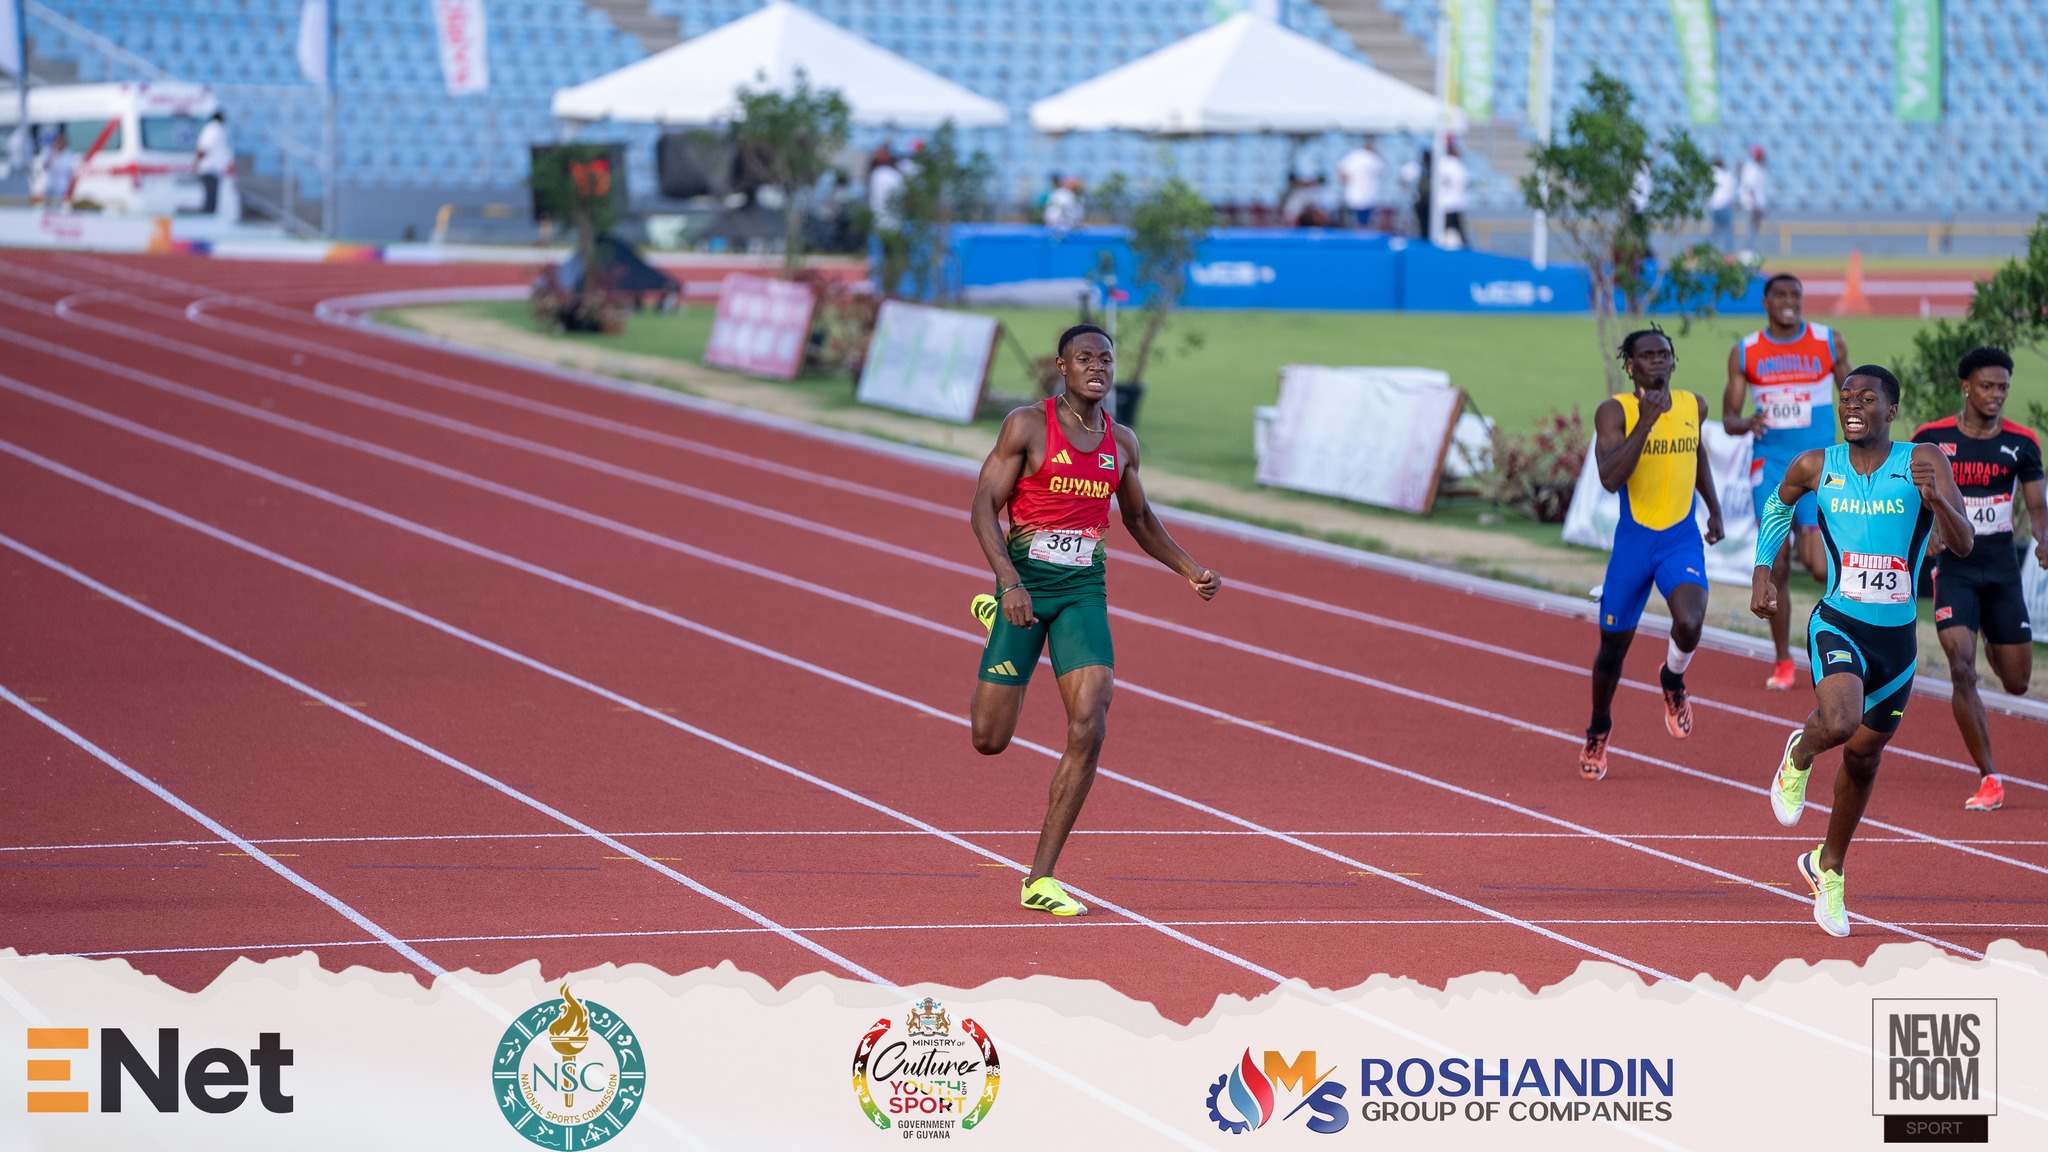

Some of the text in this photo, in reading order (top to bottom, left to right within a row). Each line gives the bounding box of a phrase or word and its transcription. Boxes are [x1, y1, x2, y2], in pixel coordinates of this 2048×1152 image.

[1757, 354, 1822, 377] ANGUILLA
[1772, 403, 1801, 419] 609
[1642, 437, 1699, 455] ARBADOS
[1049, 475, 1110, 499] GUYANA
[1953, 472, 1990, 487] OBAGO
[1830, 497, 1905, 515] BAHAMAS
[1046, 534, 1083, 553] 381
[1849, 553, 1893, 569] PUMA
[1858, 570, 1898, 591] 143
